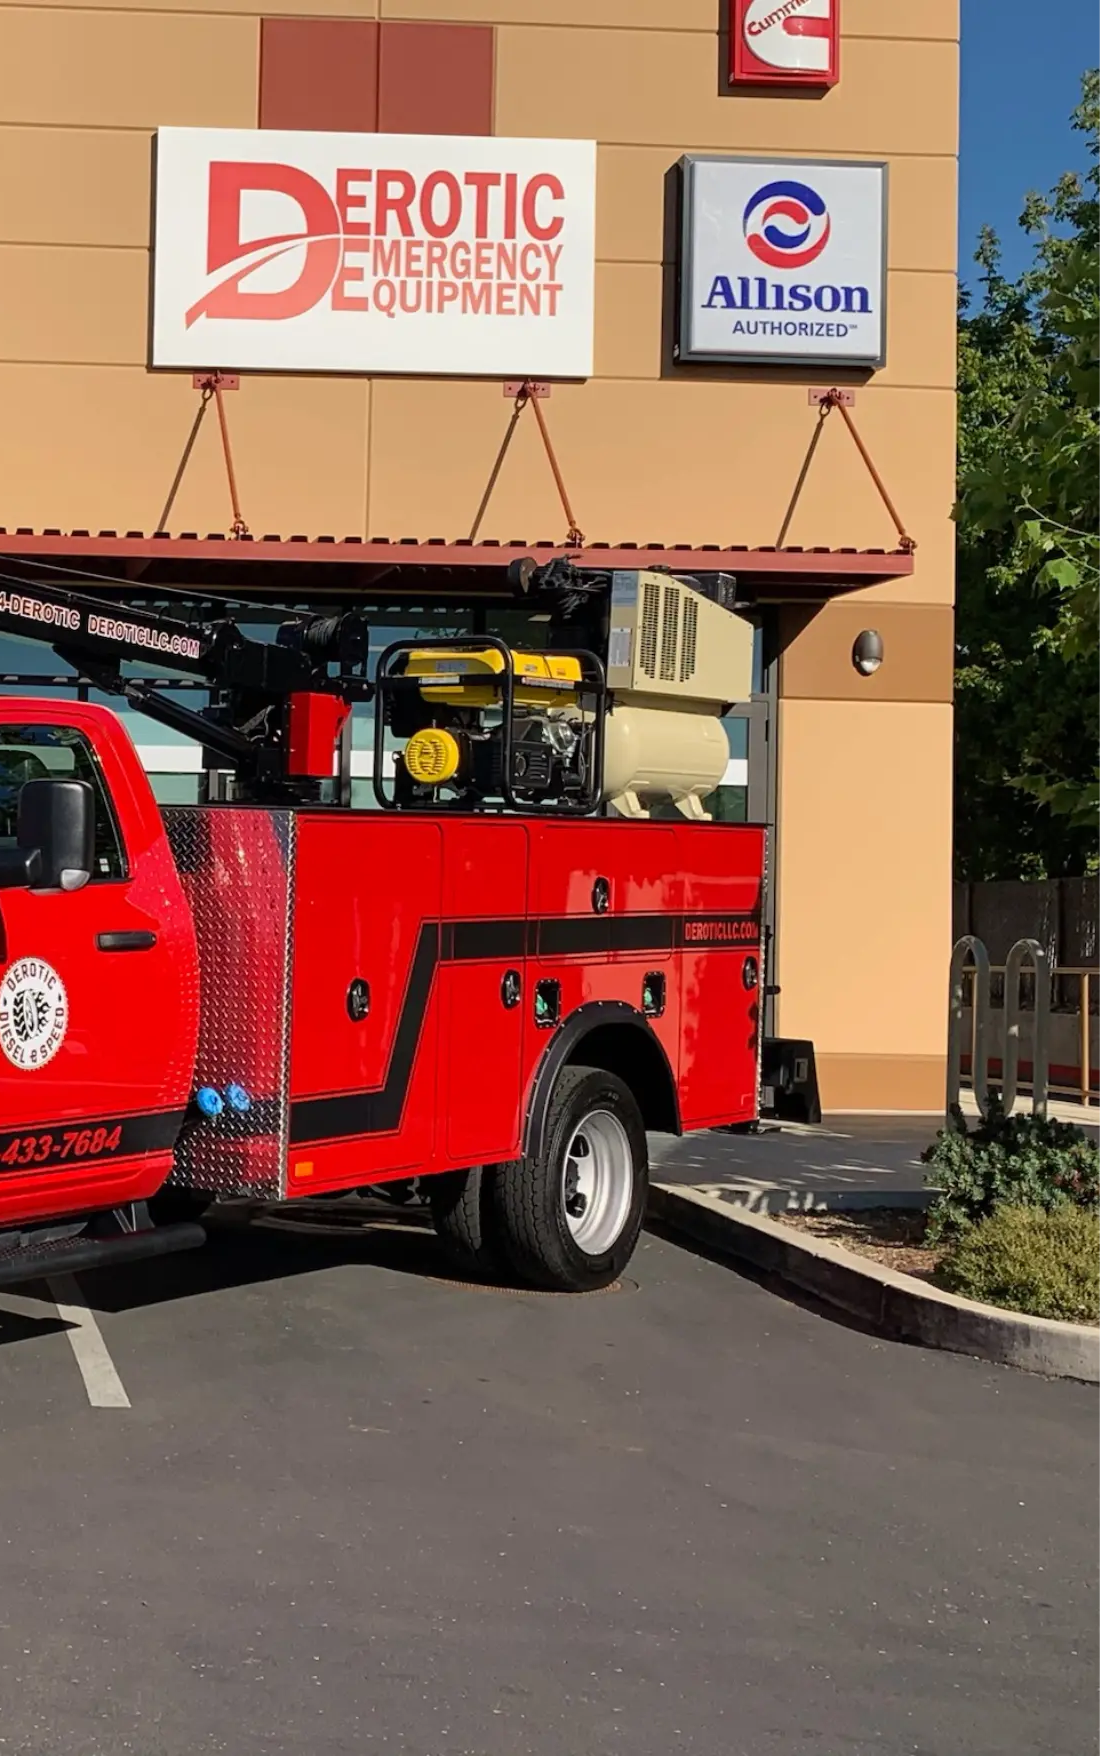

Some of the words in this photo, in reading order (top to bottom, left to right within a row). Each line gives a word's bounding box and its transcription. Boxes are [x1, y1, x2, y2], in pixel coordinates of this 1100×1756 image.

[700, 275, 873, 314] Allison
[732, 320, 849, 337] AUTHORIZED
[87, 614, 201, 659] DEROTICLLC.COM
[685, 921, 758, 941] DEROTICLLC.COM
[6, 962, 57, 992] DEROTIC
[0, 1011, 25, 1064] DIESEL
[39, 1007, 65, 1059] SPEED
